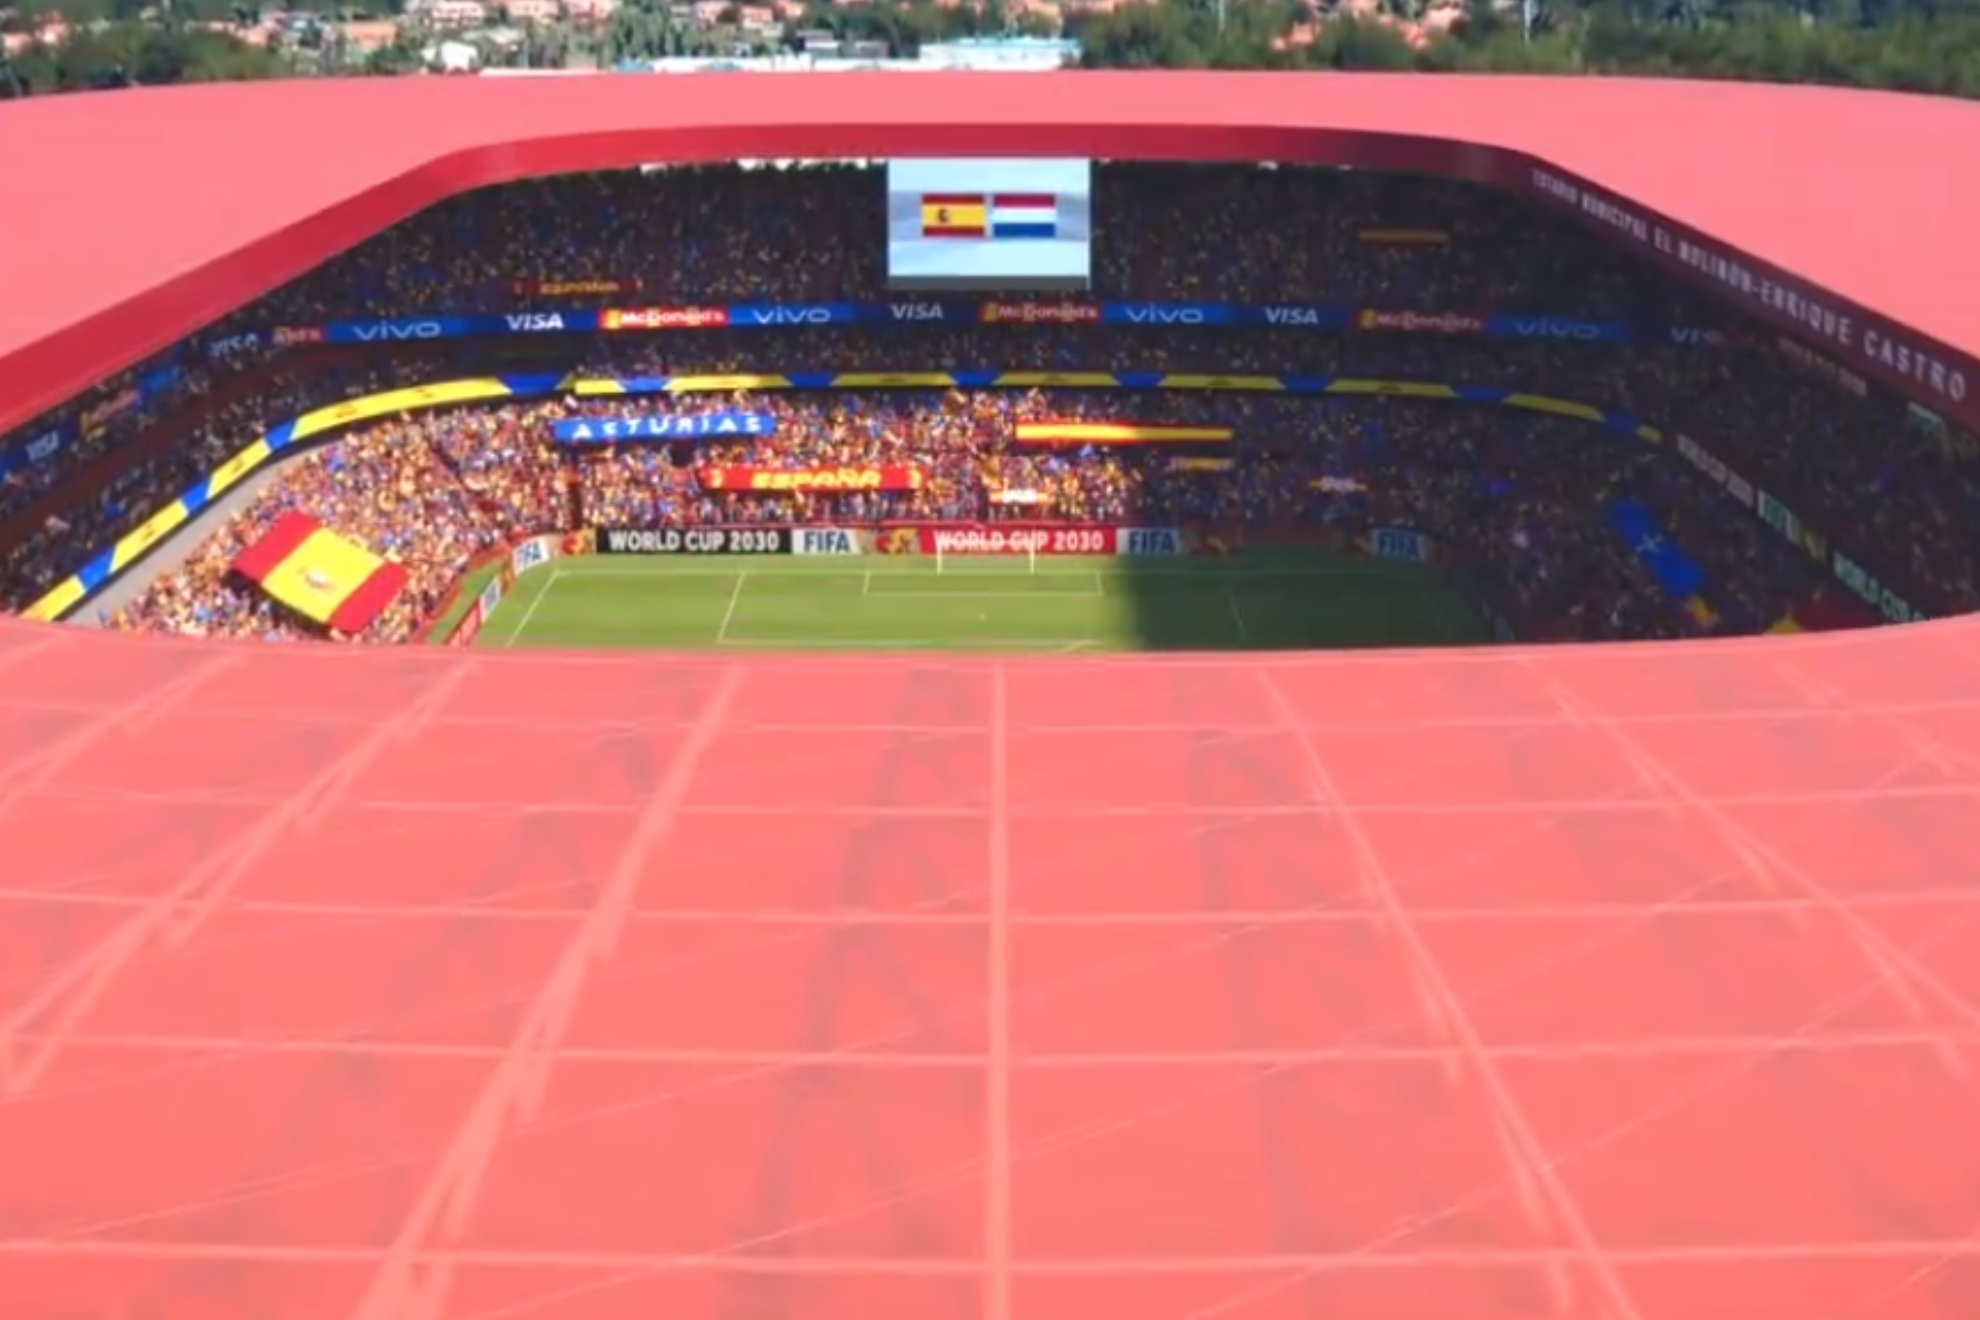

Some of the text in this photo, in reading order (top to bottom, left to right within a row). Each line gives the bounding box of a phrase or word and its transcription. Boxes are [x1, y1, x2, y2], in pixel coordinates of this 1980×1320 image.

[506, 312, 564, 330] VISA
[621, 306, 726, 327] McDonald's
[890, 303, 943, 320] VISA
[999, 303, 1097, 322] McDonald's
[1265, 307, 1319, 325] VISA
[1654, 225, 1672, 253] EL
[1864, 329, 1967, 402] CASTRO
[572, 415, 761, 440] ASTURIAS
[751, 467, 882, 489] ESPAÑA
[609, 529, 779, 551] WORLD CUP 2030
[804, 530, 850, 552] FIFA
[933, 530, 1104, 551] WORLD CUP 2030
[1129, 530, 1177, 553] FIFA
[1377, 530, 1426, 558] FIFA
